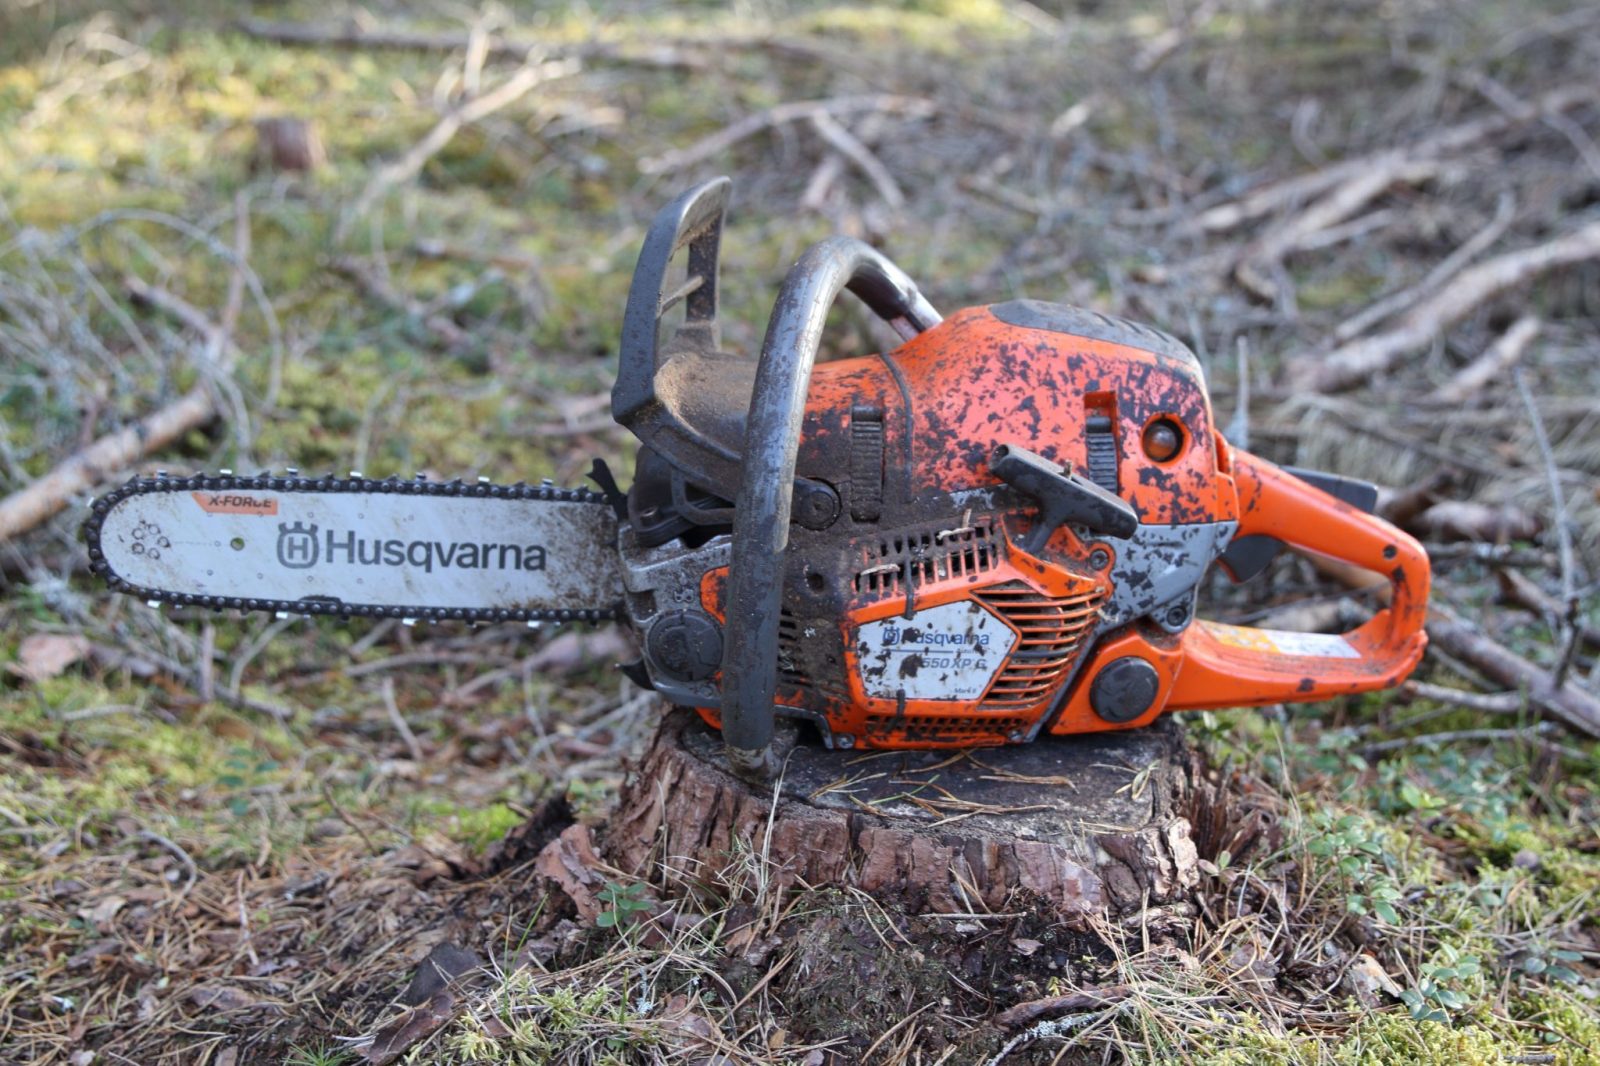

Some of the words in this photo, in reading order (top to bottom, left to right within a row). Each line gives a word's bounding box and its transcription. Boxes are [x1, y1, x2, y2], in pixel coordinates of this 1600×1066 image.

[209, 496, 272, 508] X-FORCE
[326, 529, 547, 573] Husqvarna
[922, 657, 951, 669] 550
